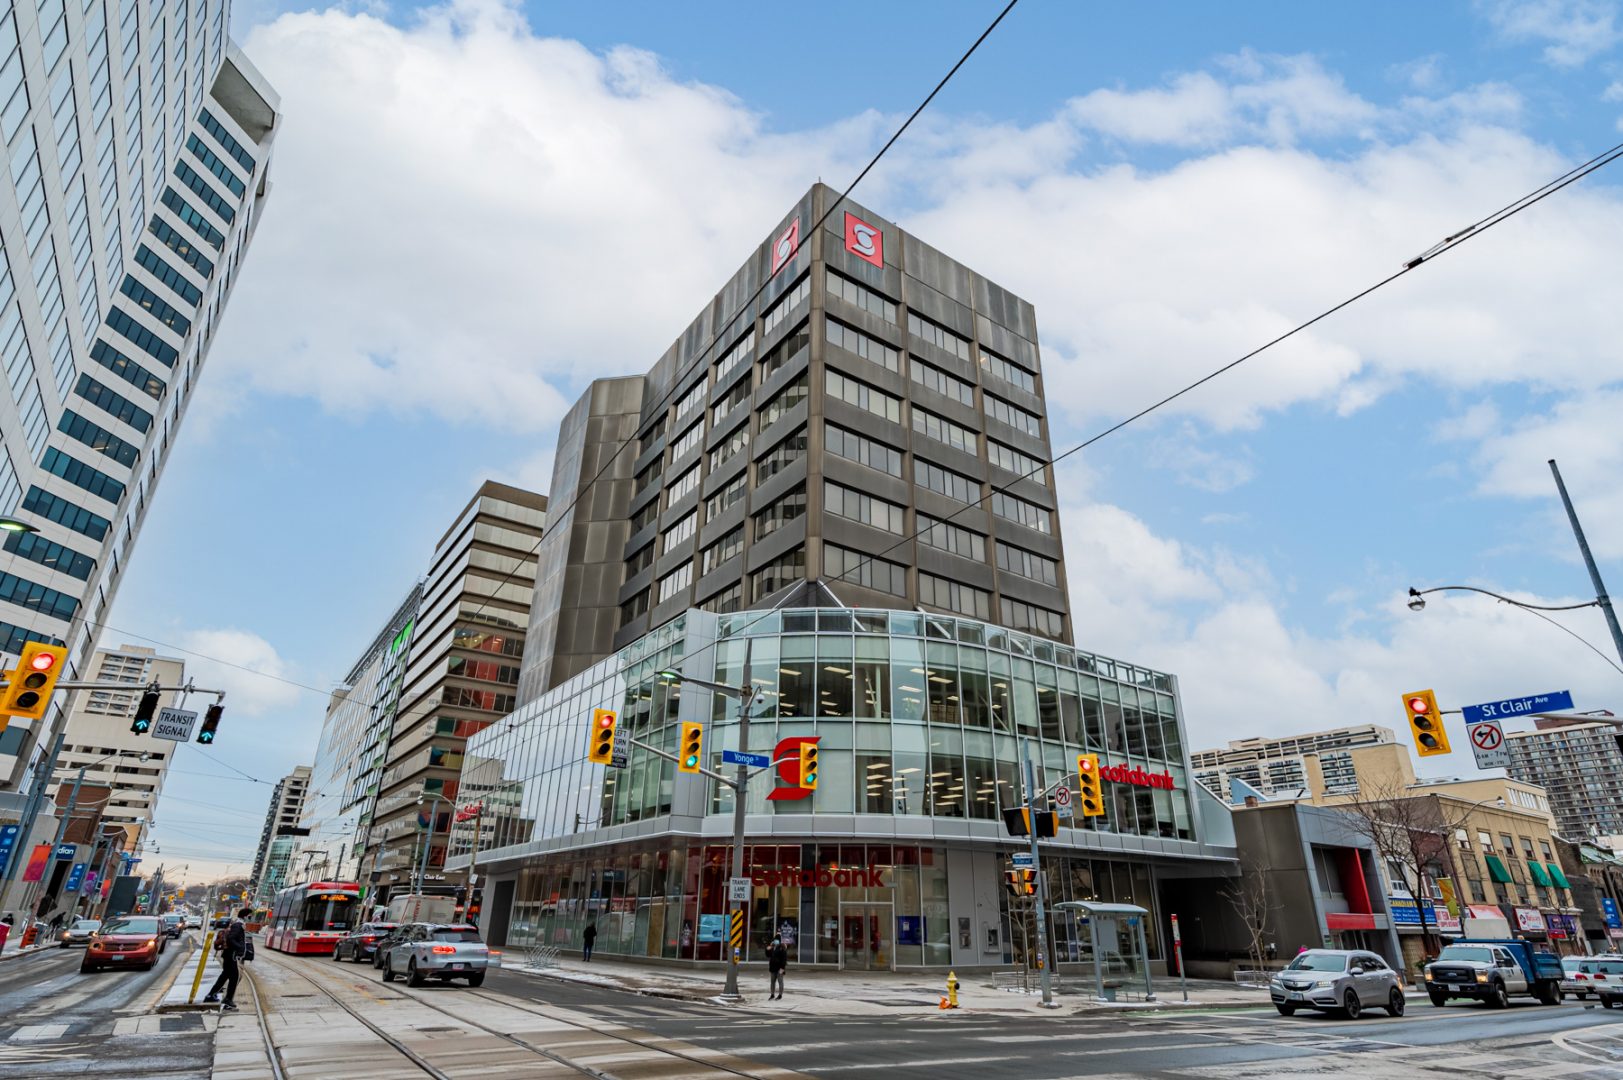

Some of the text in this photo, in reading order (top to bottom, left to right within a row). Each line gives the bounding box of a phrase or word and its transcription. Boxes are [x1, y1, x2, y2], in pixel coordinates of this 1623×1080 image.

[1481, 696, 1549, 717] St Clair Ave
[160, 711, 194, 726] TRANSIT
[157, 724, 187, 738] SIGNAL
[734, 752, 754, 764] Yonge
[57, 846, 75, 855] dian
